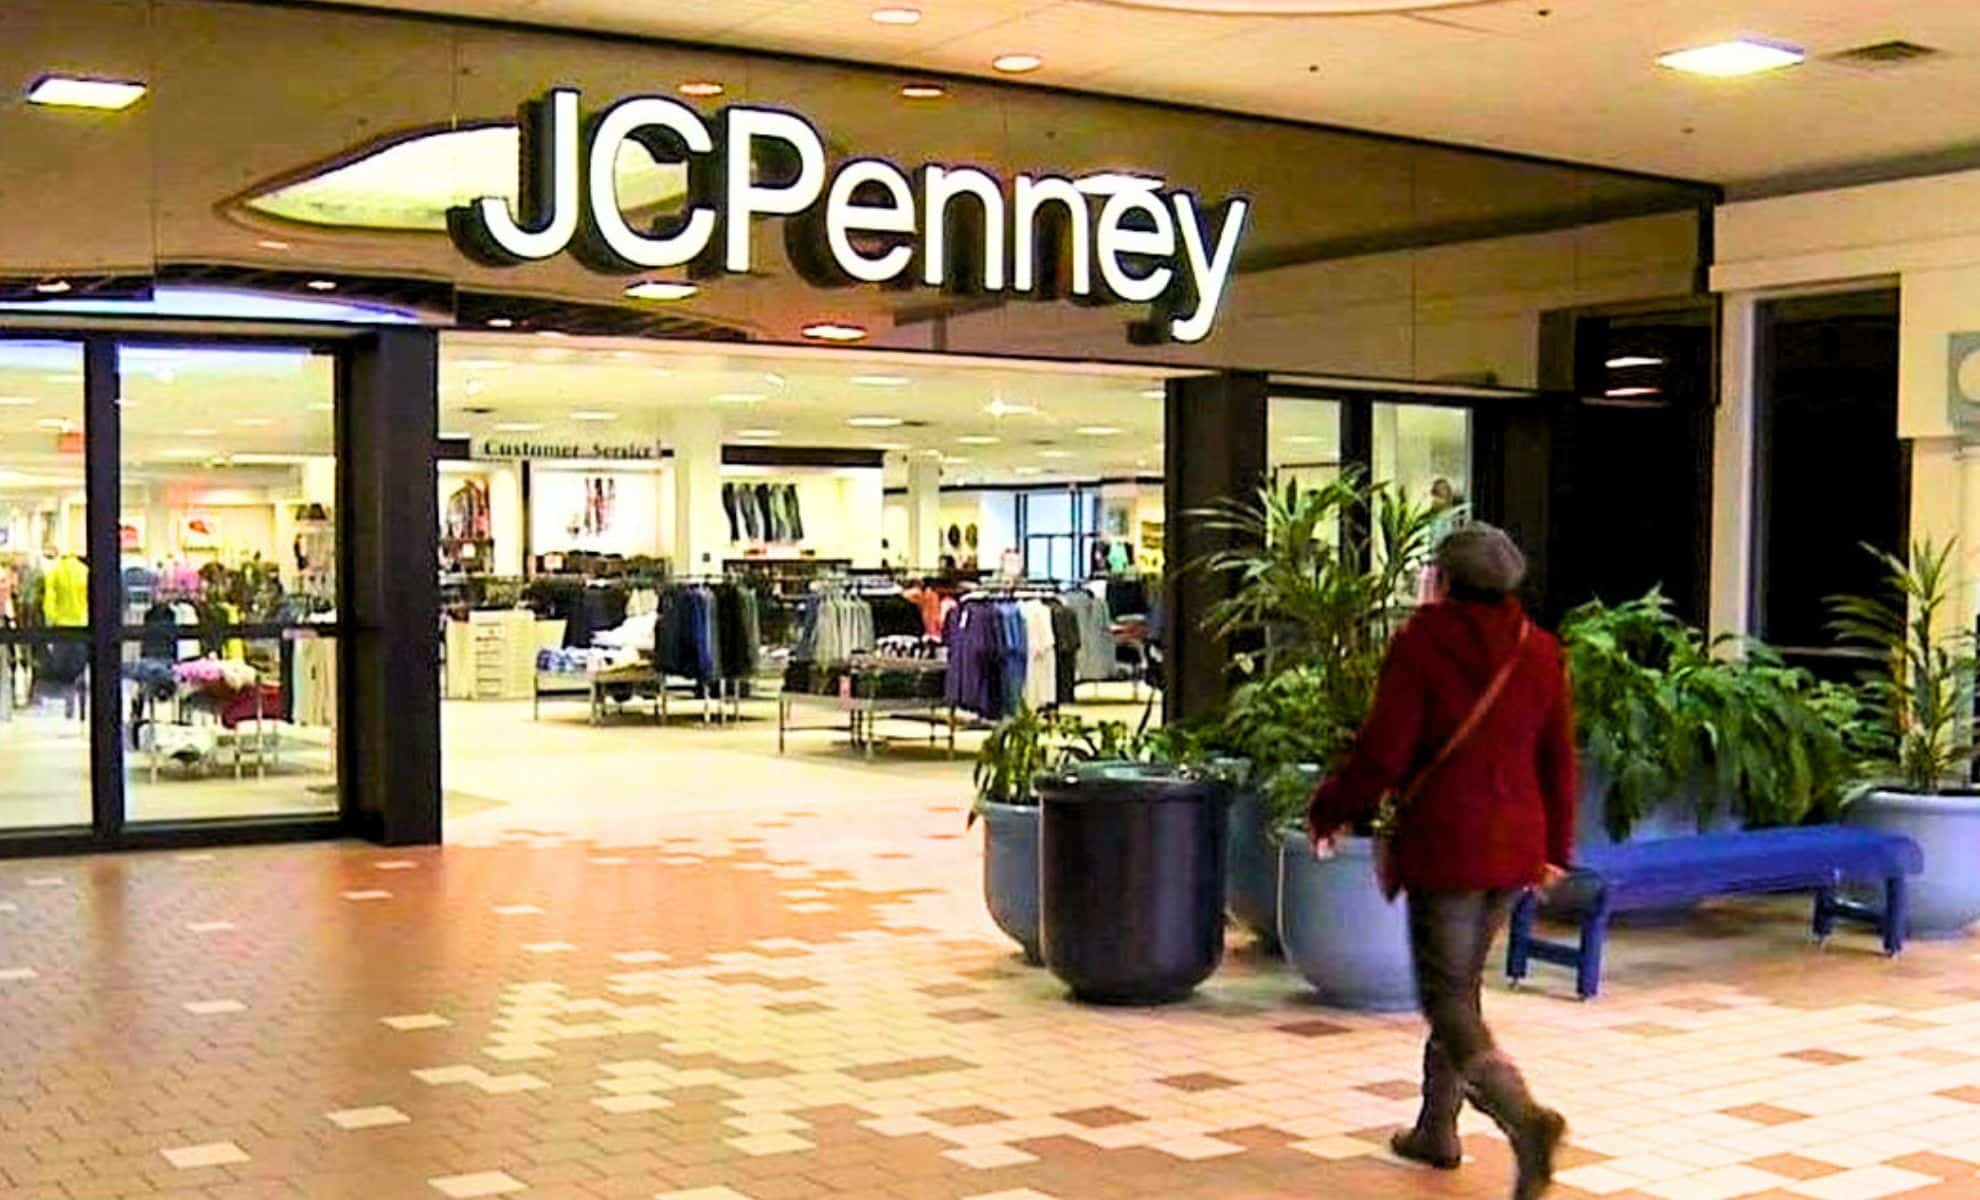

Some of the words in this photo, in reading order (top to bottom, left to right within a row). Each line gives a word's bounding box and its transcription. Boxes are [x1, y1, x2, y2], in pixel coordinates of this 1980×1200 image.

[480, 88, 1249, 342] JCPenney
[484, 440, 581, 459] Customer
[592, 442, 652, 460] Service
